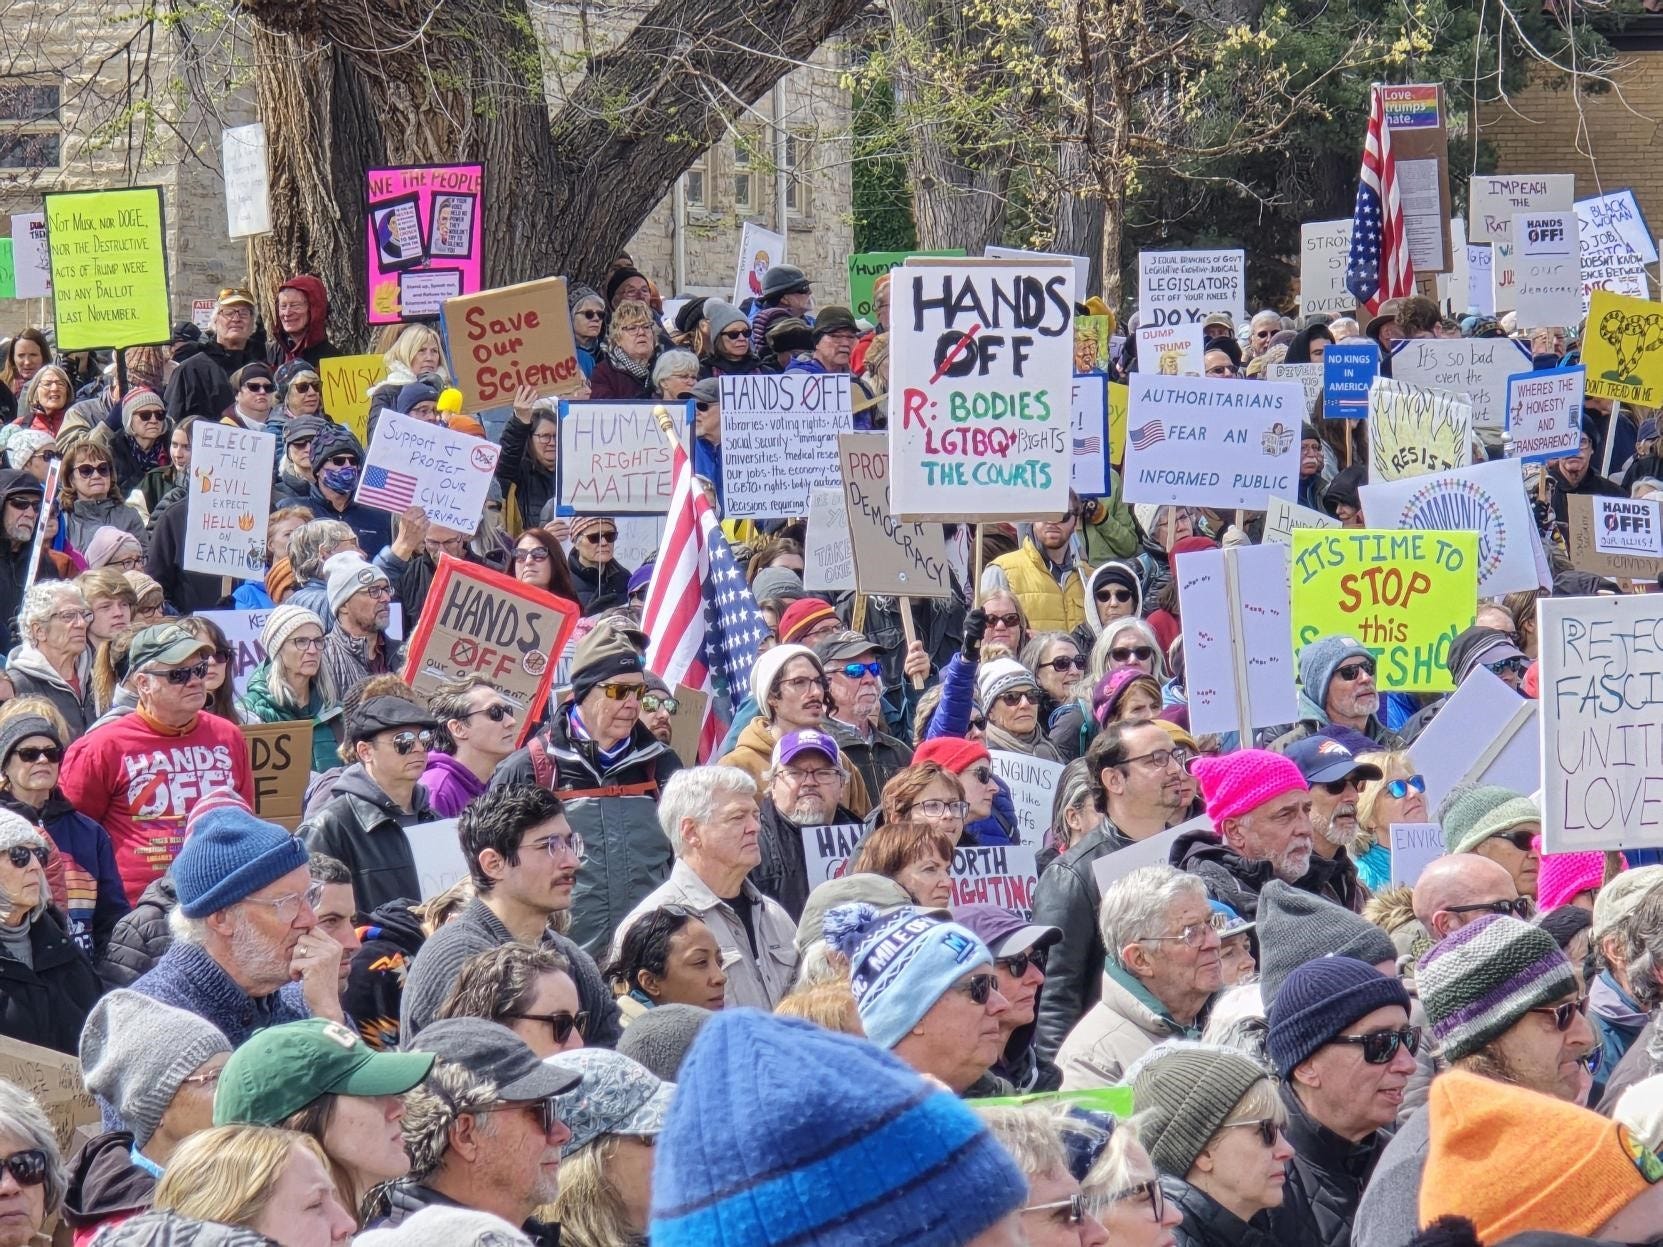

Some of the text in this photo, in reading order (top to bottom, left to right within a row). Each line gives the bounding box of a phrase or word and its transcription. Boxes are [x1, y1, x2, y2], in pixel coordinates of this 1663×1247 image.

[1385, 90, 1411, 99] Love
[1385, 102, 1426, 113] trumps
[1386, 113, 1413, 123] hate.
[369, 170, 481, 197] WE THE PEOPLE
[1488, 181, 1547, 195] IMPEACH
[1510, 199, 1530, 207] THE
[1590, 199, 1627, 217] BLACK
[49, 215, 68, 232] NOT
[100, 216, 115, 229] NOR
[118, 208, 148, 228] DOGE,
[1484, 215, 1510, 233] RAT
[1527, 219, 1563, 228] HANDS
[1592, 210, 1632, 228] WOMAN
[52, 235, 149, 254] NOR THE DESTRUCTIVE
[1528, 228, 1564, 243] OFF!
[55, 257, 148, 278] ACTS OF TRUMP WERE
[1531, 265, 1564, 276] our
[58, 280, 134, 300] ON ANY BALLOT
[1148, 277, 1238, 291] LEGISLATORS
[912, 274, 1071, 337] HANDS
[1151, 294, 1165, 302] GET
[1207, 292, 1228, 300] KNEES
[60, 304, 140, 324] LAST NOVEMBER.
[465, 306, 540, 341] Save
[1153, 308, 1181, 327] DO
[1143, 329, 1174, 340] DUMP
[930, 323, 1034, 384] OFF
[1154, 341, 1191, 352] TRUMP
[1417, 343, 1494, 370] It's so bad
[1328, 355, 1370, 364] NO KINGS
[476, 356, 578, 401] Science
[1344, 369, 1353, 377] IN
[1436, 369, 1483, 384] even the
[721, 375, 849, 411] HANDS OFF
[1329, 382, 1369, 391] AMERICA
[1518, 378, 1573, 398] WHERES THE
[1607, 383, 1629, 398] TREAD
[1631, 387, 1641, 400] ON
[1642, 388, 1653, 401] ME
[950, 389, 1051, 422] BODIES
[1141, 389, 1283, 409] AUTHORITARIANS
[1526, 397, 1565, 416] HONESTY
[384, 420, 436, 450] Support
[574, 410, 684, 451] HUMAN
[725, 415, 850, 437] libraries voting rights ACA
[1168, 425, 1248, 443] FEAR AN
[1537, 418, 1555, 432] AND
[201, 427, 262, 453] ELECT
[755, 434, 788, 454] security
[1513, 432, 1577, 453] TRANSPARENCY?
[219, 453, 248, 470] THE
[409, 451, 466, 475] PROTECT
[592, 447, 670, 473] RIGHTS
[786, 448, 814, 460] medical
[727, 466, 825, 480] our jobs the economy
[921, 459, 1052, 490] THE COURTS
[1139, 470, 1288, 490] INFORMED PUBLIC
[200, 478, 251, 495] DEVIL
[440, 478, 466, 492] OUR
[570, 471, 672, 504] MATTE
[764, 479, 810, 494] rights bodily
[212, 499, 249, 510] EXPECT
[421, 488, 461, 510] CIVIL
[728, 498, 804, 514] Decisions requiring
[1414, 493, 1491, 532] OMMUNITY
[1603, 503, 1650, 516] HANDS
[202, 513, 235, 530] HELL
[1604, 513, 1650, 535] OFF!
[219, 532, 231, 541] ON
[850, 482, 944, 587] DEMOCRACY
[196, 543, 245, 567] EARTH
[1295, 535, 1464, 584] IT'S TIME TO
[1339, 566, 1432, 613] STOP
[440, 580, 542, 652] HANDS
[1358, 615, 1408, 643] this
[426, 658, 448, 672] our
[450, 637, 516, 679] OFF
[1556, 672, 1663, 719] FASCI
[1557, 723, 1663, 775] UNIT
[125, 745, 232, 780] HANDS
[1022, 790, 1040, 806] like
[1564, 776, 1663, 829] LOVE
[953, 847, 1008, 875] ORTH
[951, 875, 1037, 910] IGHTING
[868, 929, 915, 972] MILE
